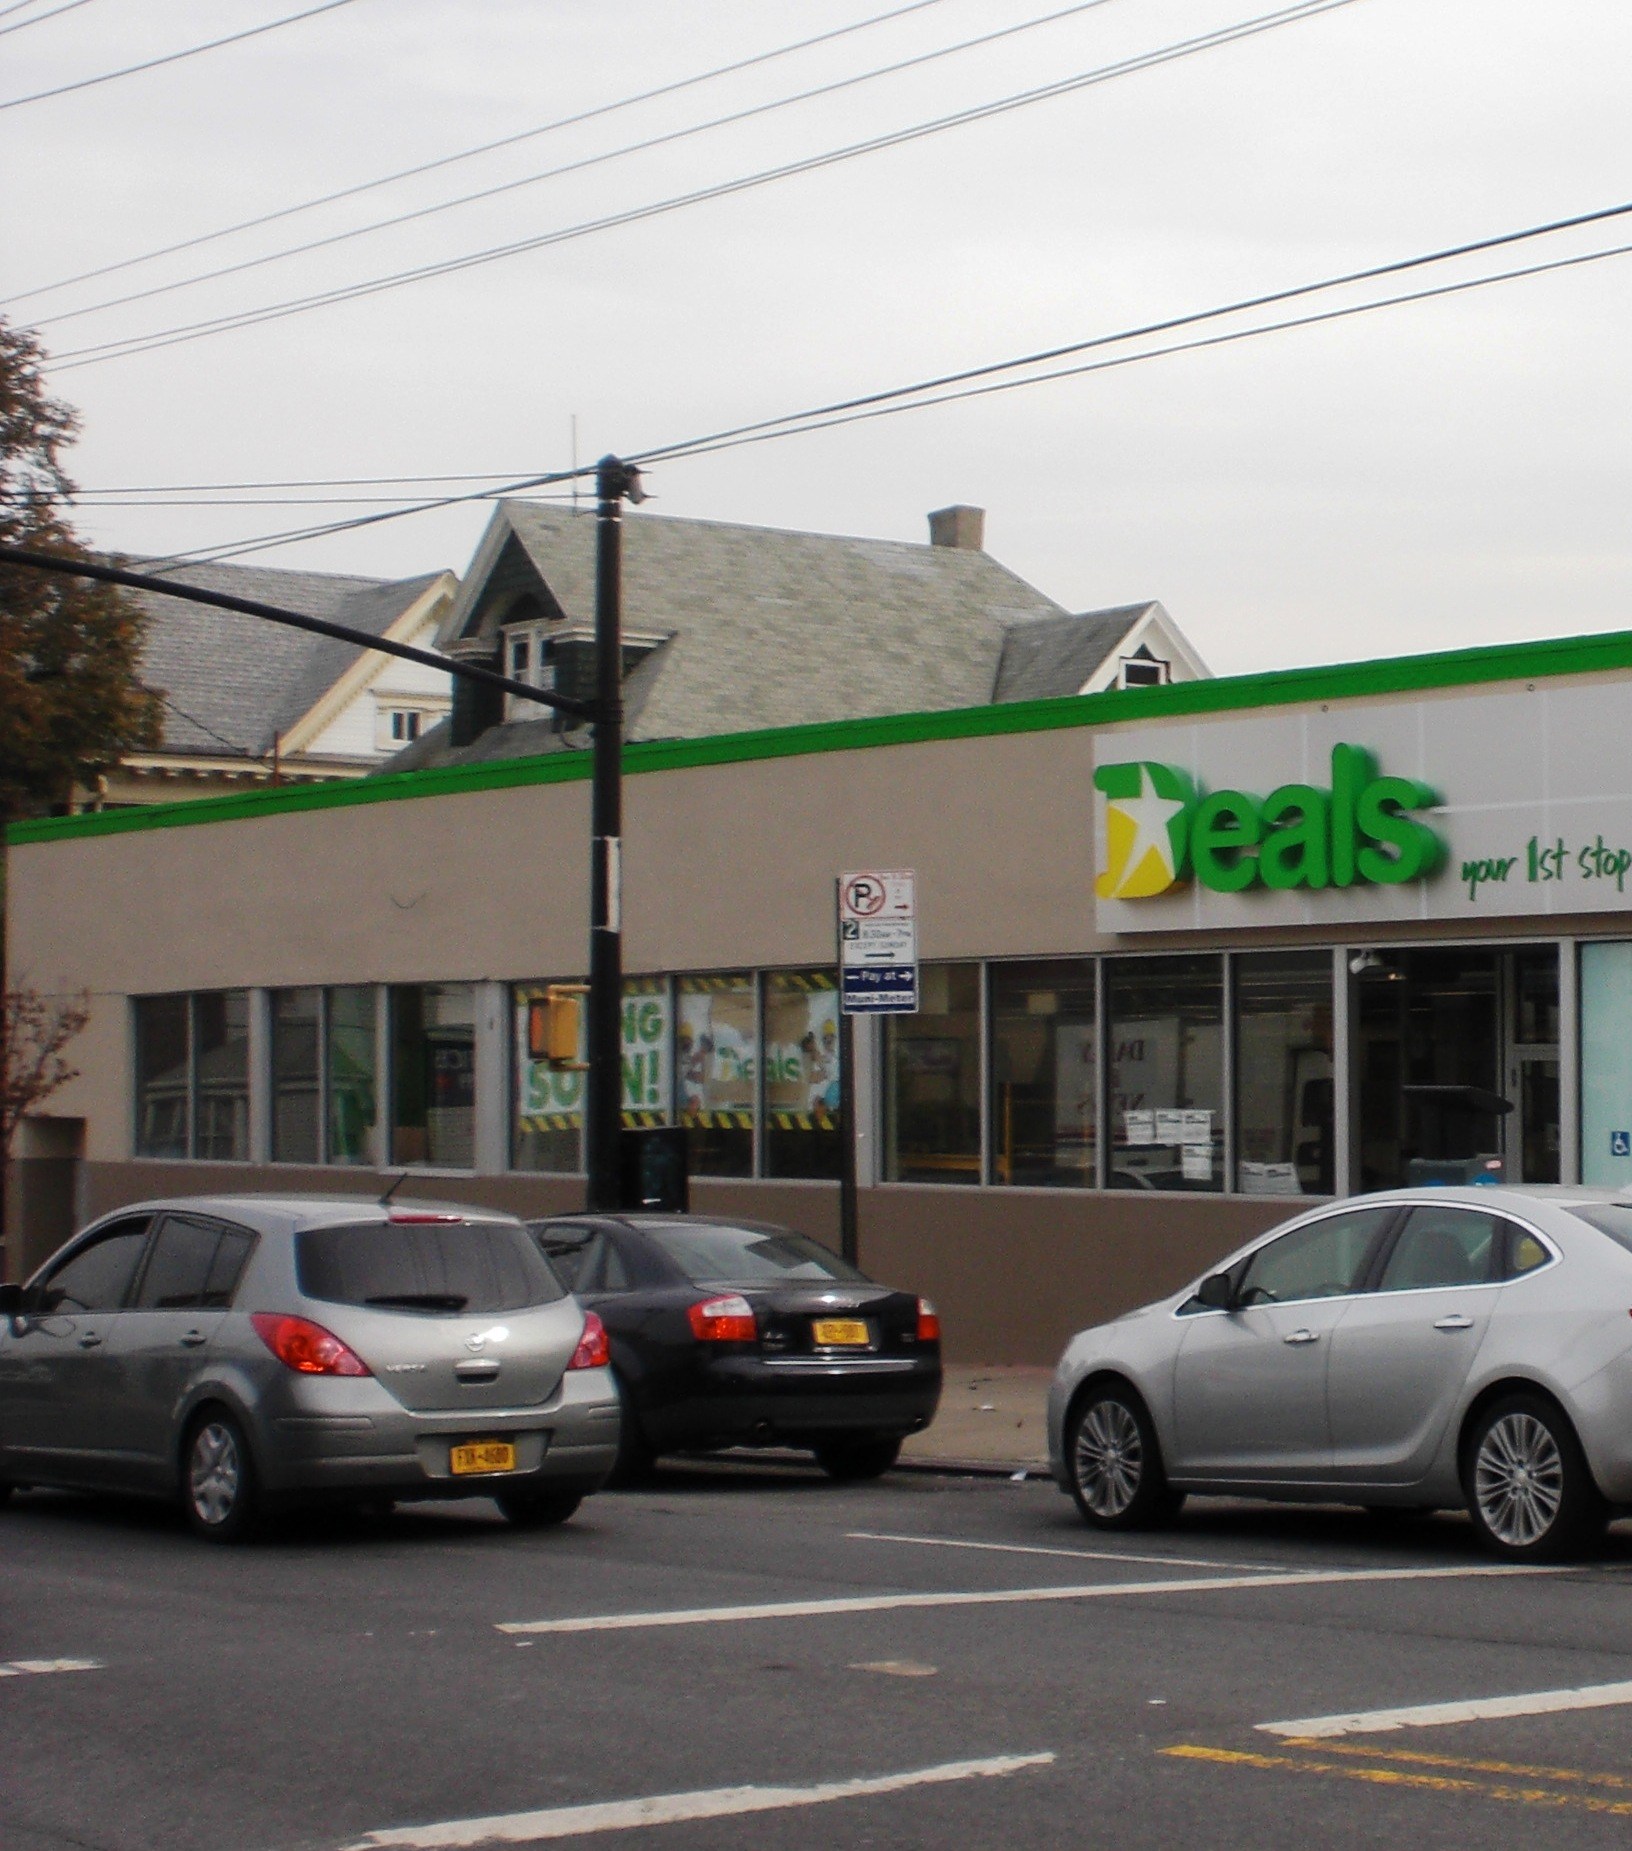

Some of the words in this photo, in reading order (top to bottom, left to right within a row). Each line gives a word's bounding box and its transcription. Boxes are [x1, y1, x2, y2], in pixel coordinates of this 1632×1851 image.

[1461, 856, 1518, 901] your
[1527, 835, 1569, 883] 1st
[1577, 834, 1632, 893] stop
[861, 970, 881, 984] Pay
